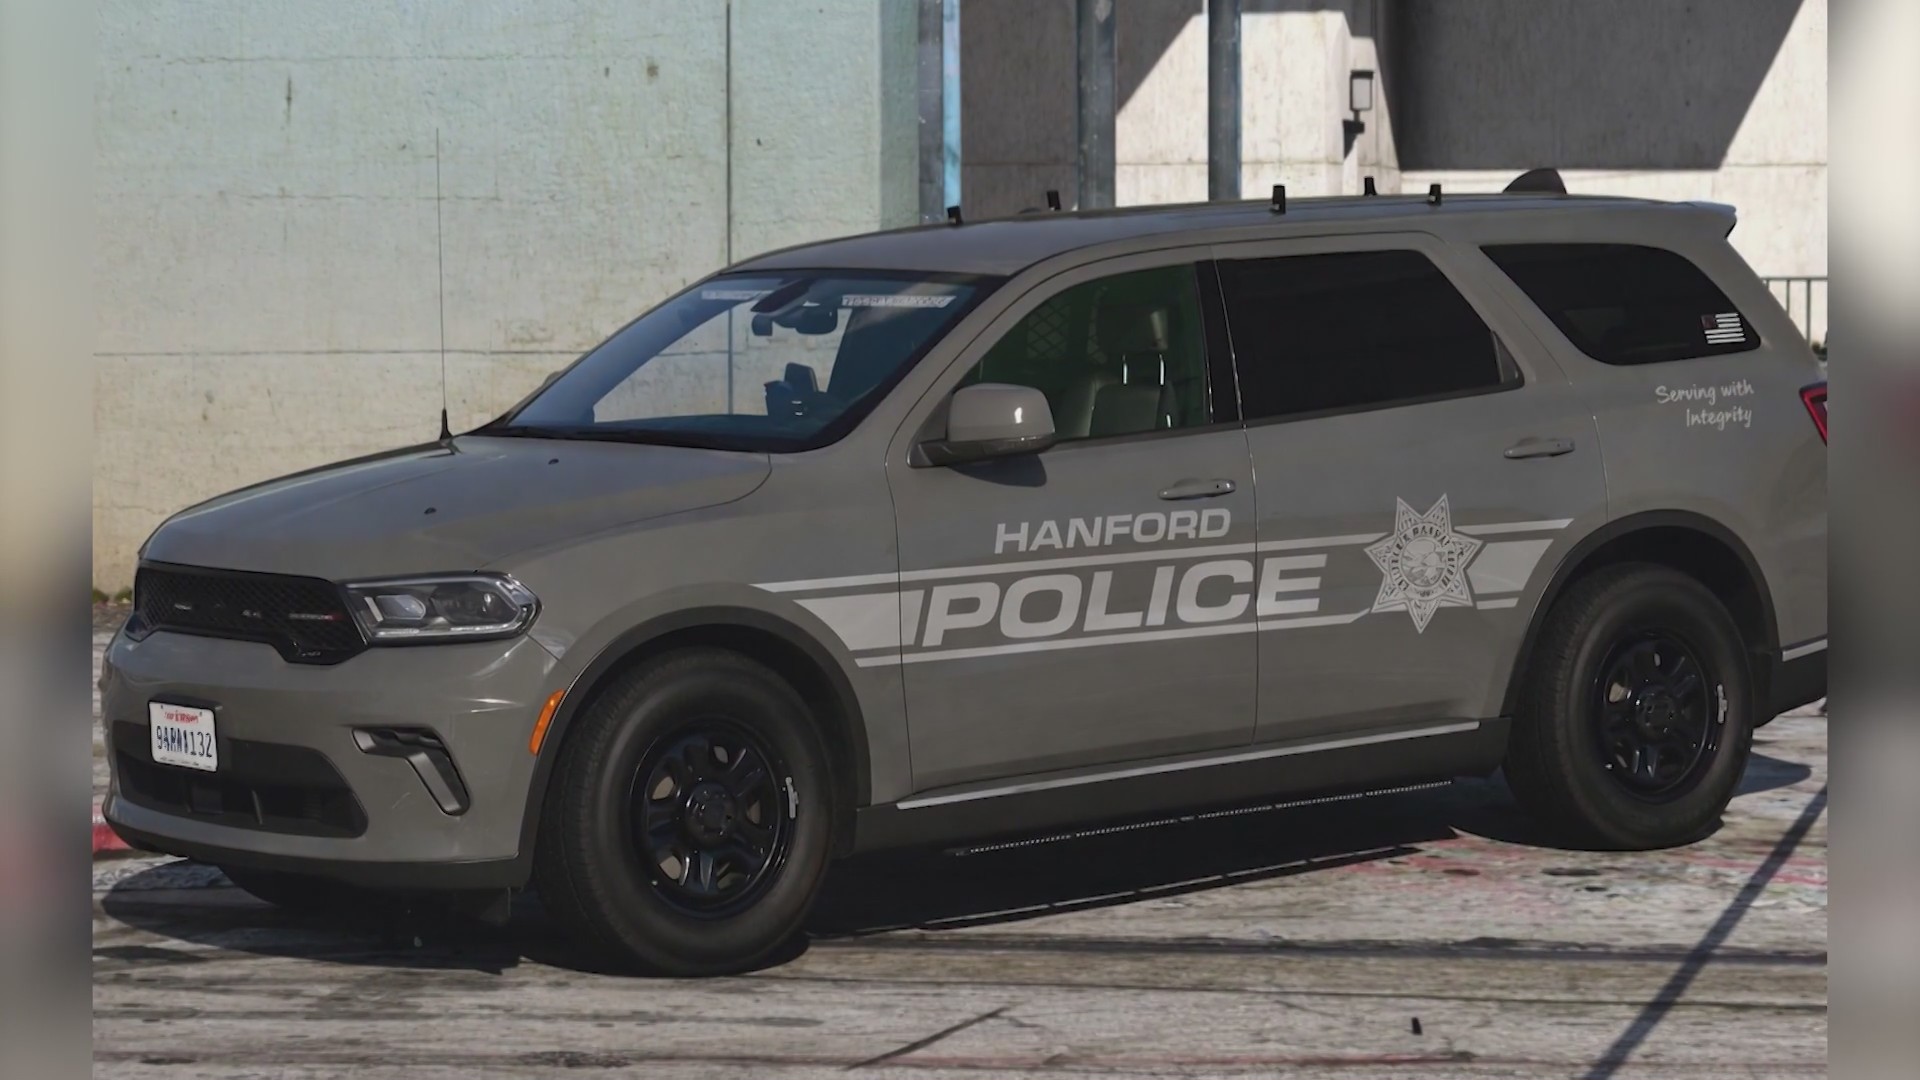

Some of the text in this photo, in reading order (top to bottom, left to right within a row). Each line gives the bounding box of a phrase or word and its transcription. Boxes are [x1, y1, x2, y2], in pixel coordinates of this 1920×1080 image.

[1655, 379, 1754, 406] Serving with
[1686, 405, 1752, 431] Integrity
[994, 508, 1231, 554] HANFORD
[922, 554, 1327, 647] POLICE
